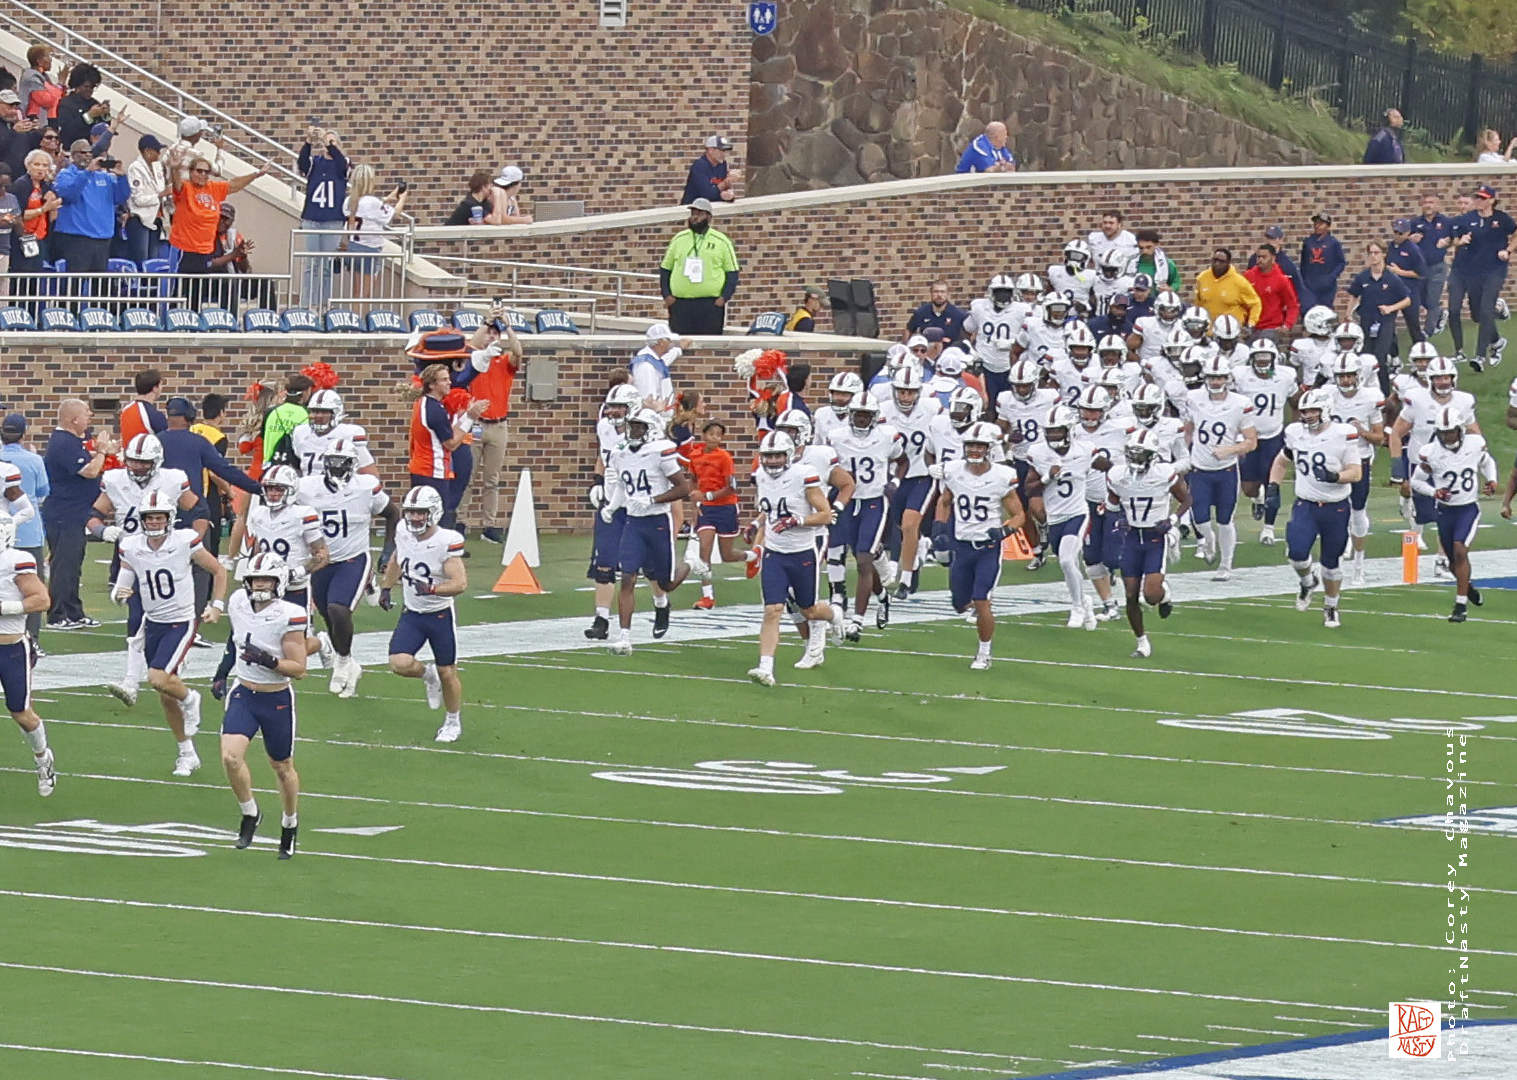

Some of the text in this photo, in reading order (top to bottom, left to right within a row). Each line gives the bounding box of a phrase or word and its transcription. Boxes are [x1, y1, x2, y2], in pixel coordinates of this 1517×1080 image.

[311, 181, 335, 208] 41
[1, 310, 29, 325] DUKE
[45, 311, 73, 326] DUKE
[83, 311, 112, 326] DUKE
[125, 311, 156, 326] DUKE
[171, 311, 199, 326] DUKE
[204, 311, 233, 326] DUKE
[249, 311, 279, 326] DUKE
[286, 311, 315, 328] DUKE
[329, 311, 358, 328] DUKE
[371, 311, 400, 328] DUKE
[414, 311, 444, 328] DUKE
[541, 311, 570, 328] DUKE
[1255, 393, 1276, 417] 91
[1198, 420, 1227, 445] 69
[303, 452, 328, 477] 7
[851, 457, 875, 484] 13
[621, 468, 652, 497] 84
[1441, 467, 1474, 495] 28
[123, 505, 140, 534] 6
[957, 493, 989, 522] 85
[1129, 496, 1153, 522] 17
[322, 509, 348, 539] 51
[400, 557, 434, 587] 43
[145, 568, 175, 601] 10
